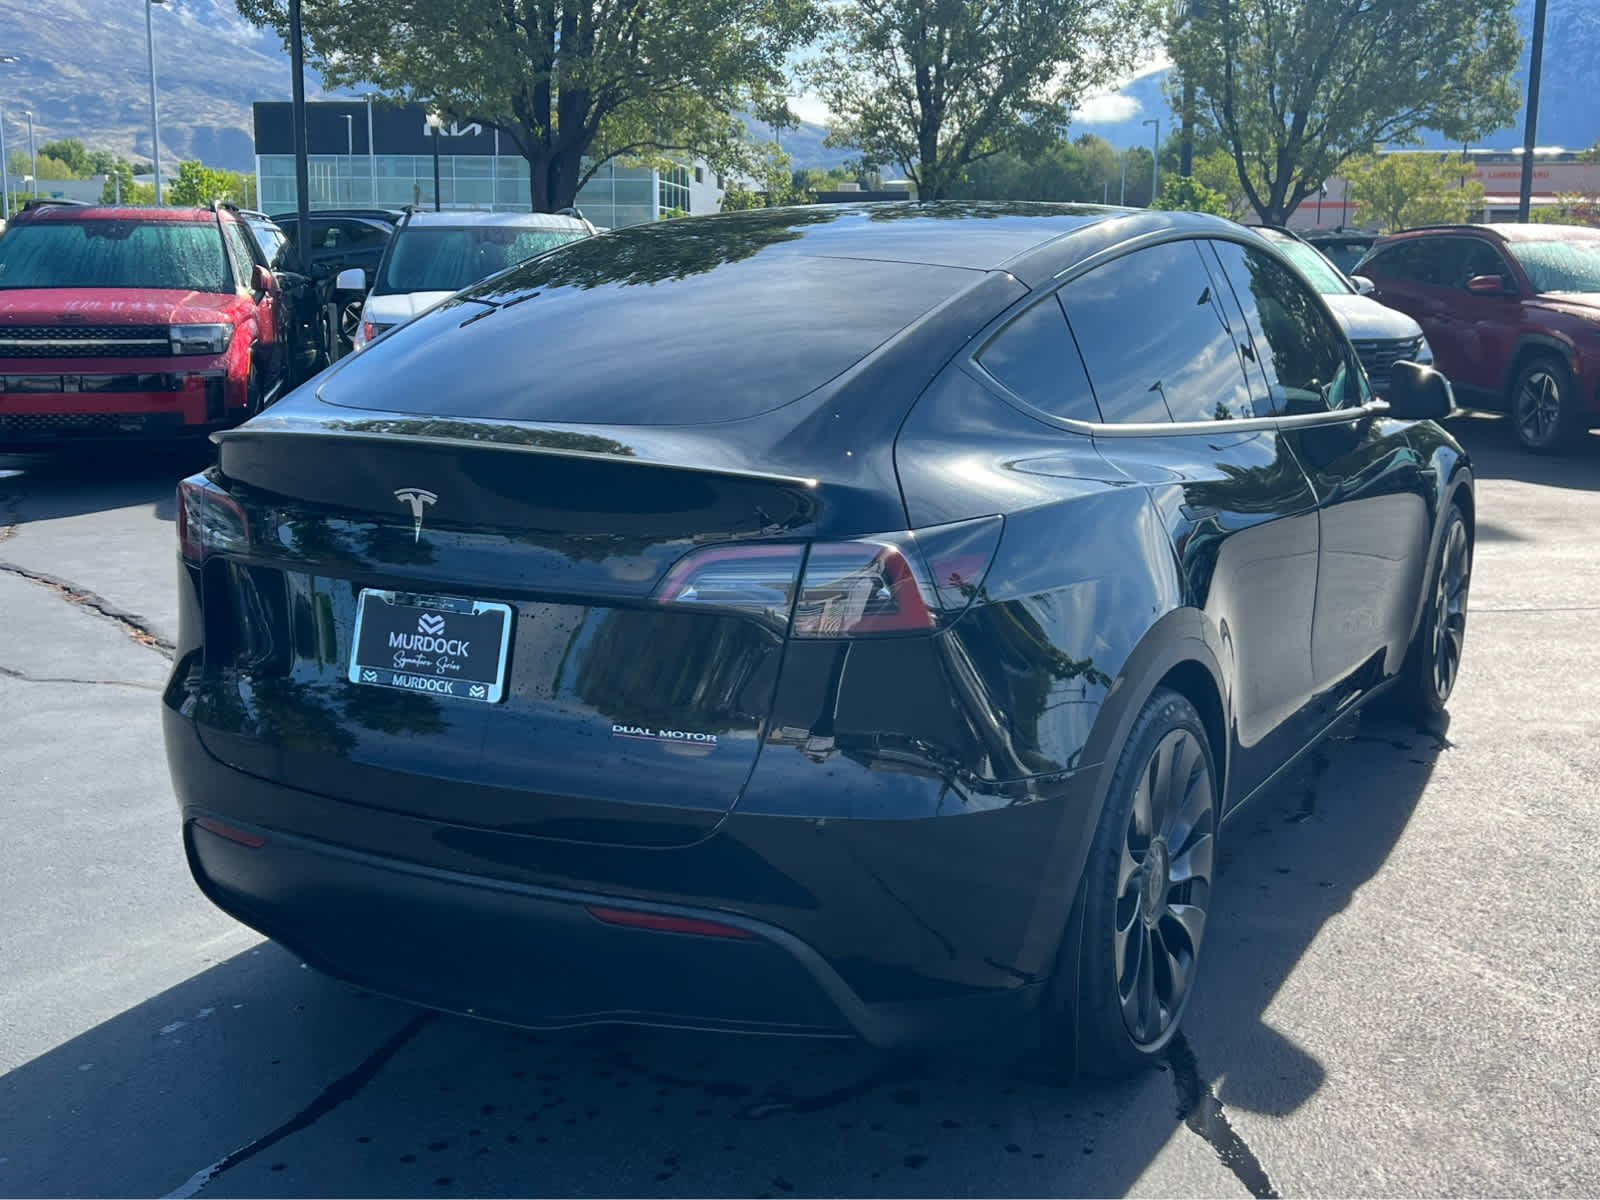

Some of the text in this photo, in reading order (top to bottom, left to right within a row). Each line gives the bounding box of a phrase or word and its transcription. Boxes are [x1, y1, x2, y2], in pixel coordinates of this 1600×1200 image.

[388, 631, 470, 657] MURDOCK
[392, 674, 454, 694] MURDOCK
[612, 724, 718, 742] DUAL MOTOR
